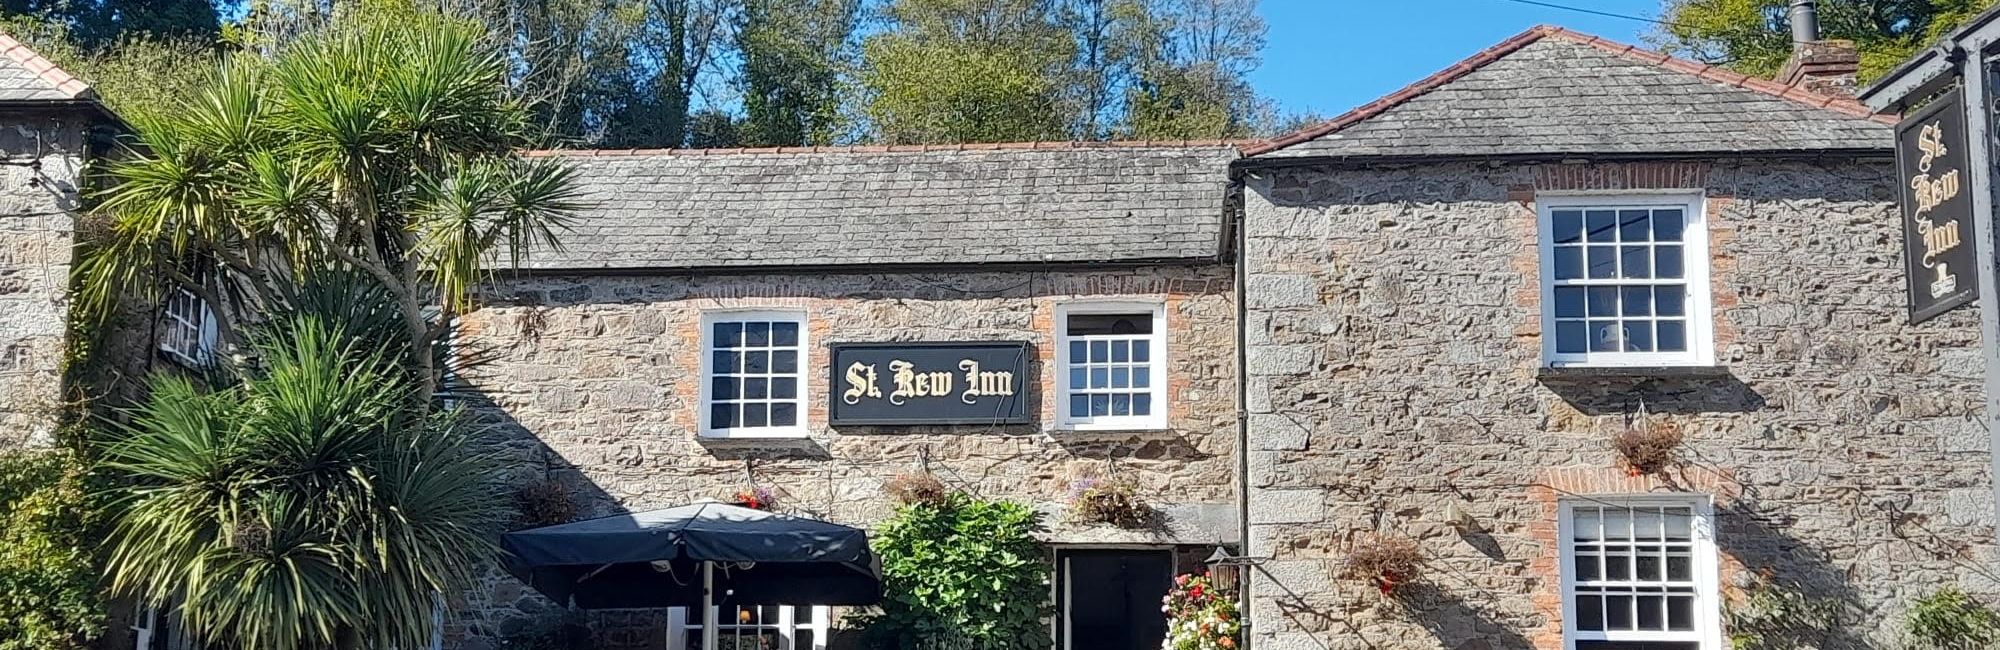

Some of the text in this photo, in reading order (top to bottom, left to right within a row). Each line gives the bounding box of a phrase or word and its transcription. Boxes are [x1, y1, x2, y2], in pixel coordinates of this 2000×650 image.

[1911, 169, 1959, 222] Kew
[1918, 219, 1960, 268] Inn
[889, 359, 953, 406] Kew
[958, 359, 1014, 404] Inn
